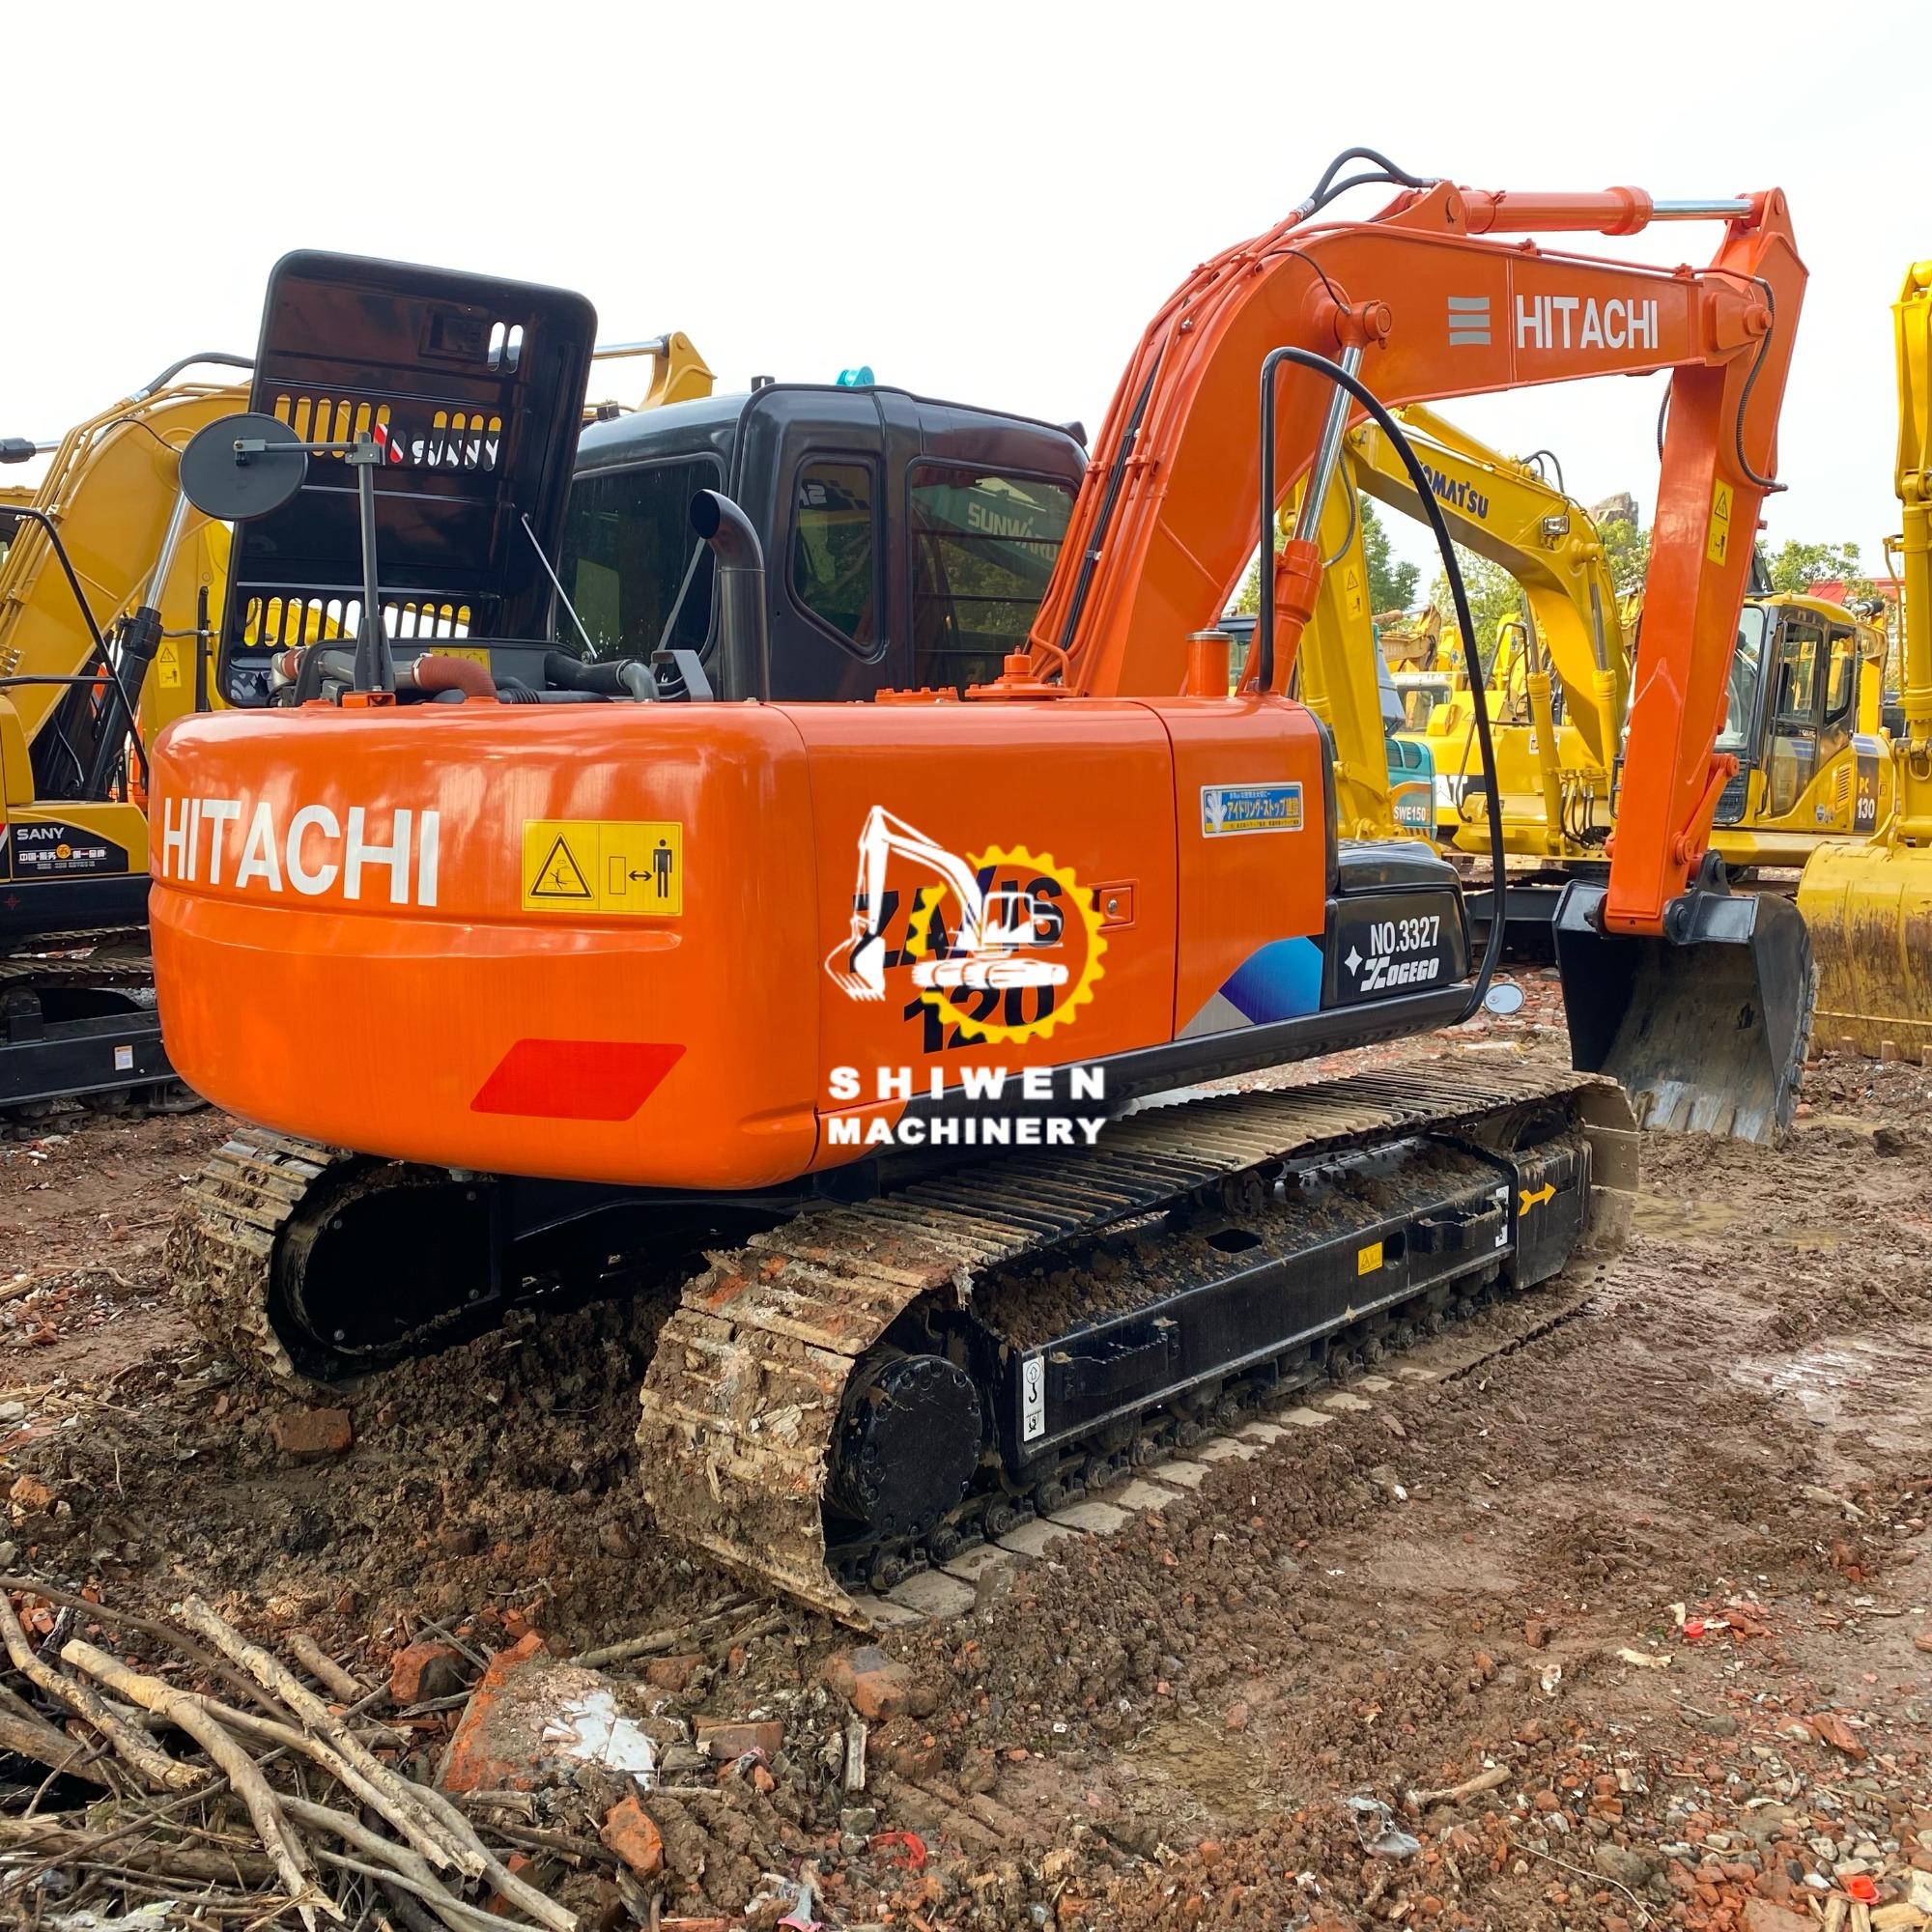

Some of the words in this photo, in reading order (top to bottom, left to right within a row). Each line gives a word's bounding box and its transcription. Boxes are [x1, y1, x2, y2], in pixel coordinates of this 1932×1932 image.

[1516, 295, 1659, 349] HITACHI
[1408, 460, 1490, 519] MATSU
[968, 501, 1058, 562] SUNWARD
[1858, 797, 1875, 819] 130
[1859, 777, 1870, 794] PC
[16, 827, 65, 840] SANY
[162, 797, 440, 907] HITACHI
[1371, 915, 1440, 956] NO.3327
[903, 983, 1055, 1054] 120
